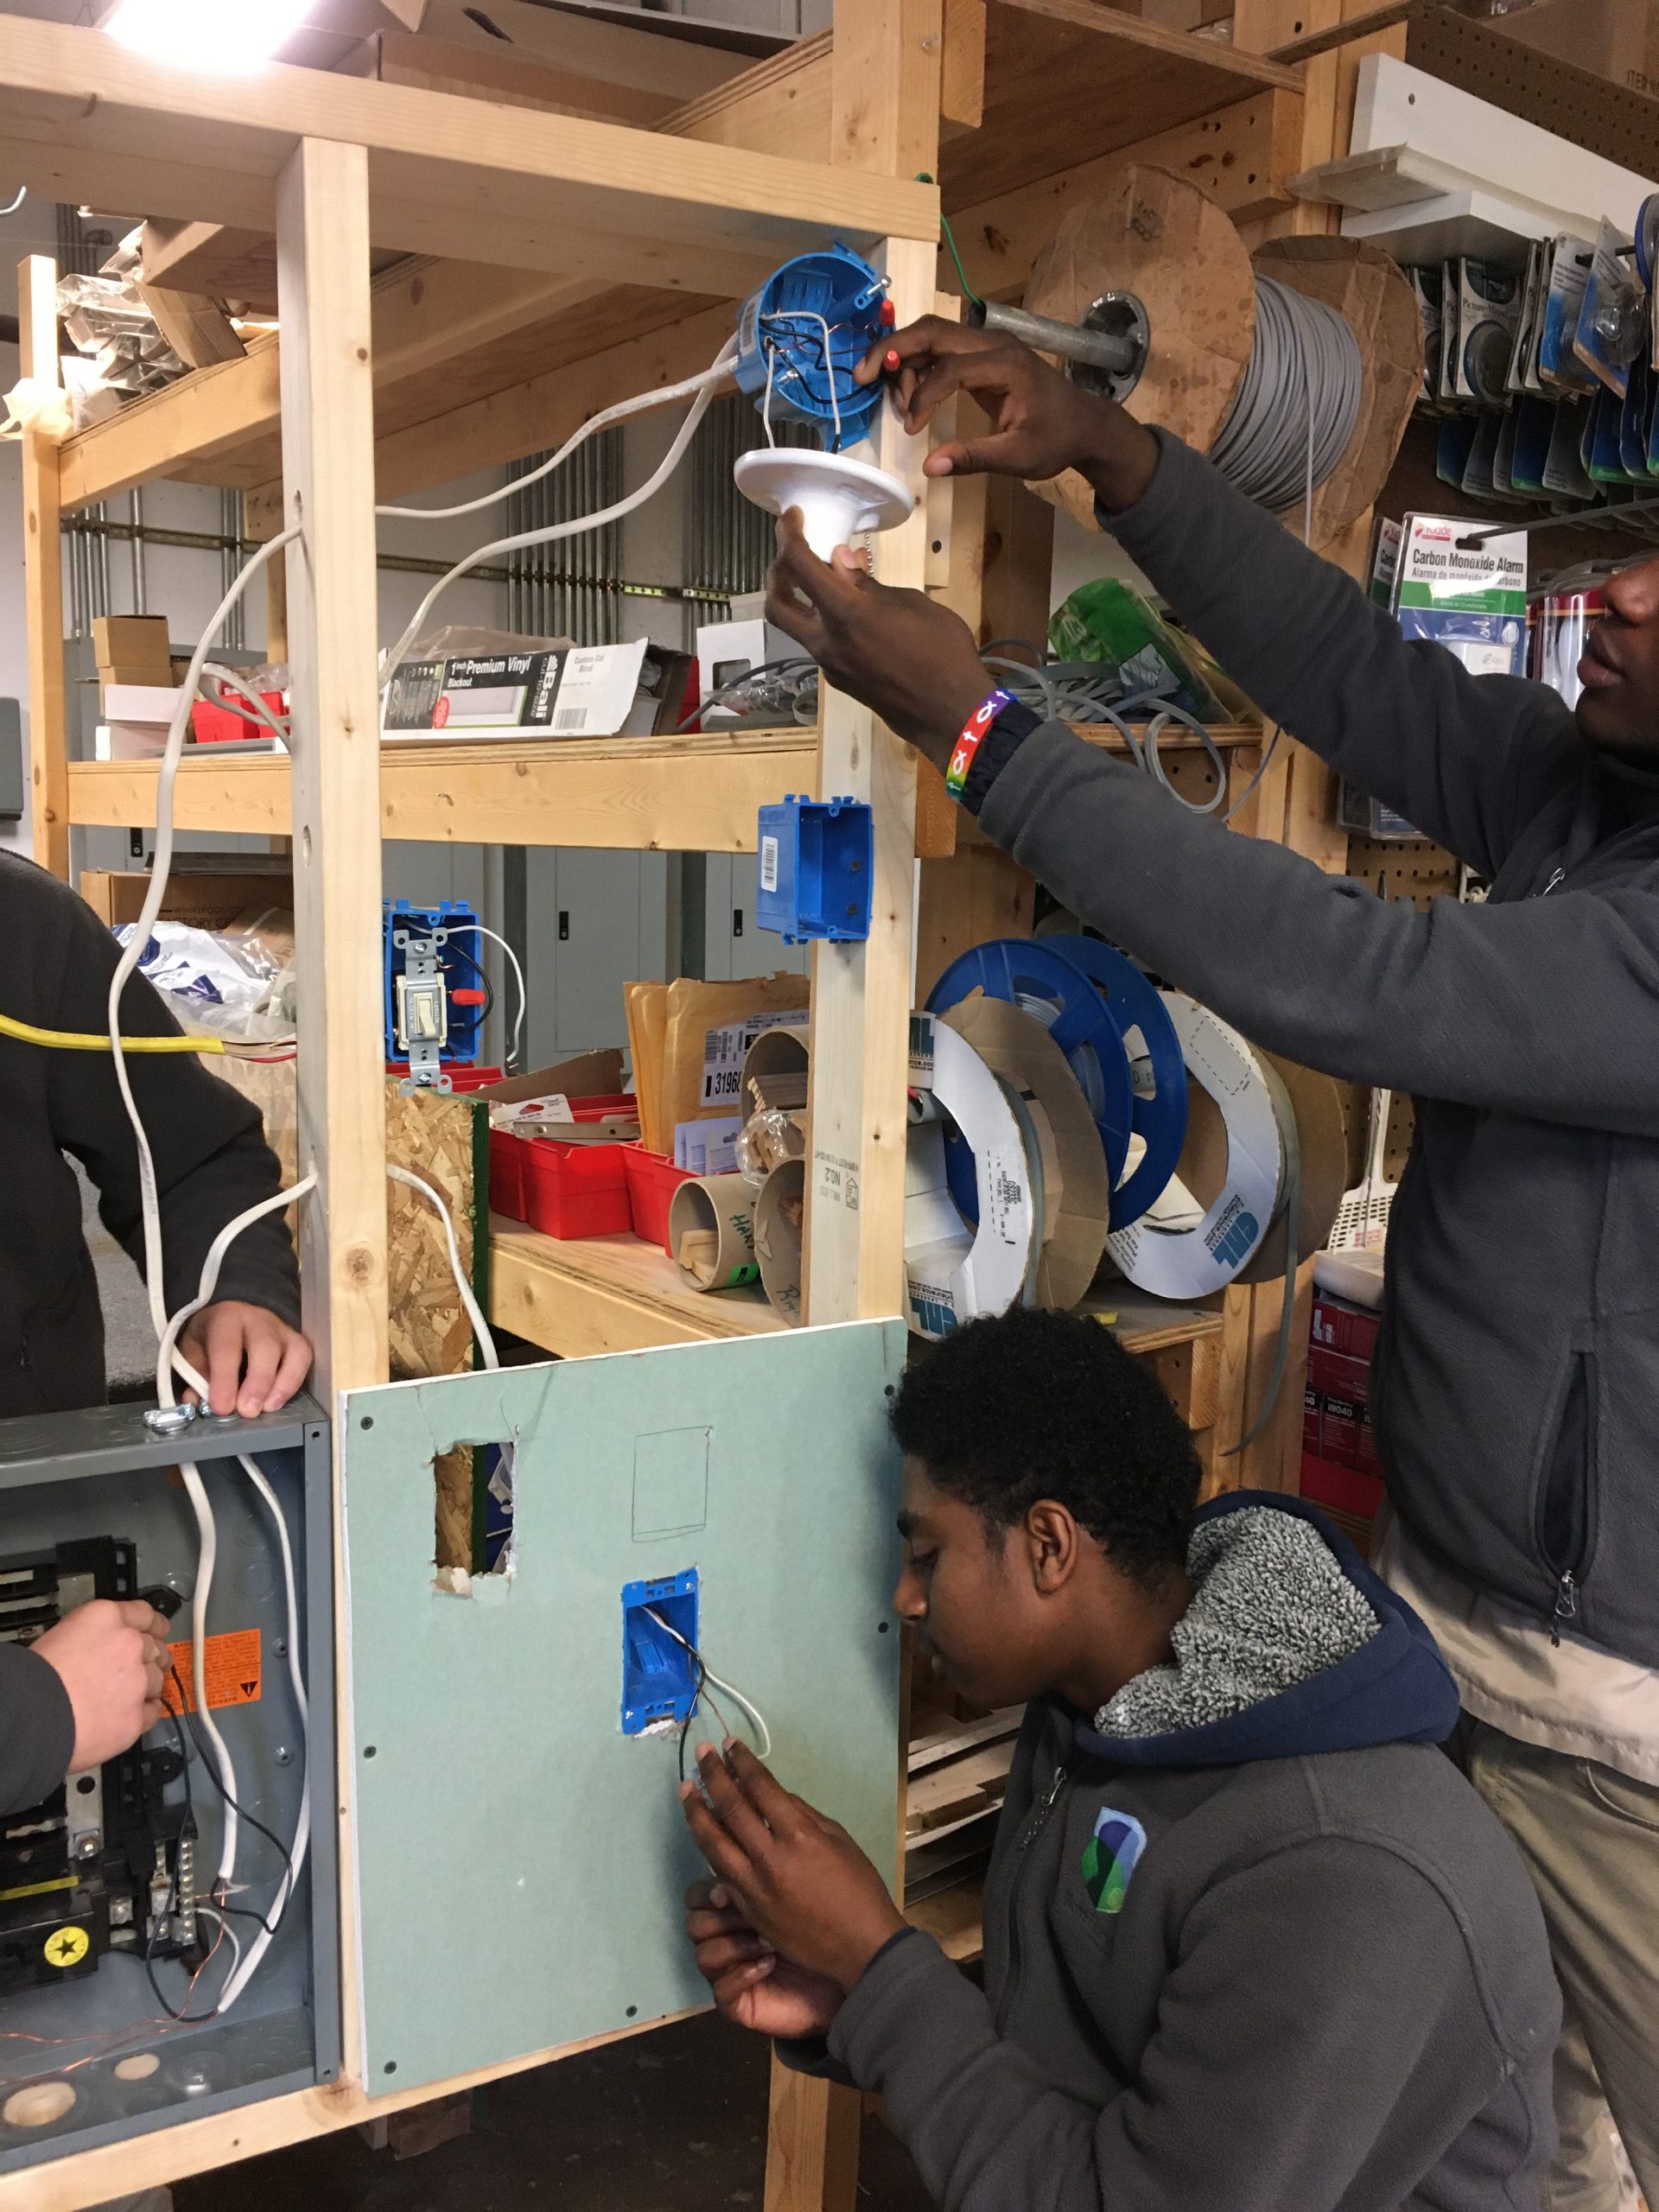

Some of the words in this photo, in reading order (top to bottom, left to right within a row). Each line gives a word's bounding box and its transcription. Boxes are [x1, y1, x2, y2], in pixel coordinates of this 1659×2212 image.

[1413, 548, 1446, 567] Carbon
[1448, 552, 1495, 571] Monoxide
[1497, 557, 1523, 574] Alarm
[1412, 567, 1437, 580] Alarma
[1438, 570, 1447, 581] de
[467, 658, 505, 675] Premium
[507, 656, 532, 674] Vinyl
[448, 677, 473, 688] Blackout
[536, 671, 556, 718] Bali
